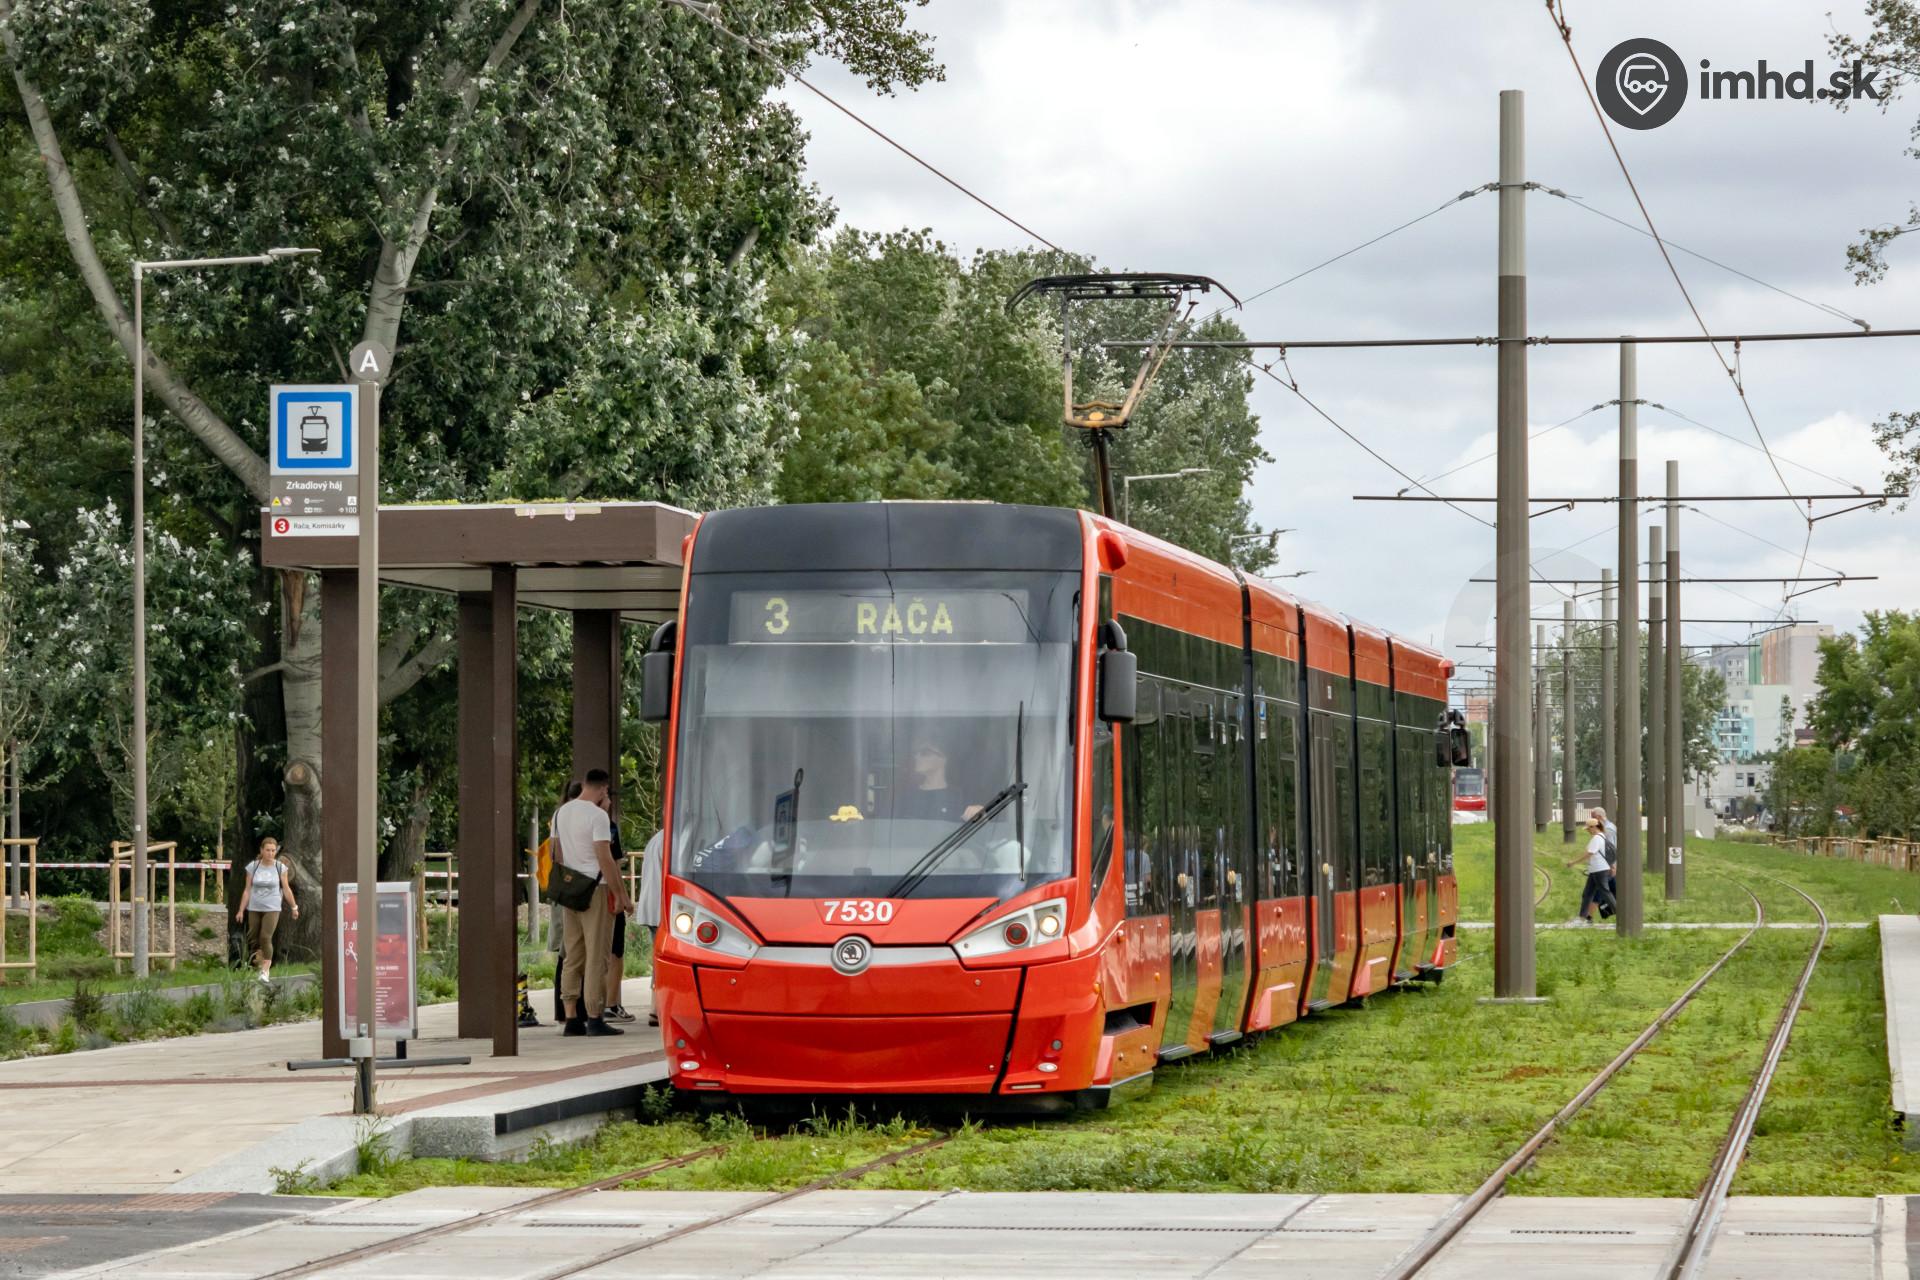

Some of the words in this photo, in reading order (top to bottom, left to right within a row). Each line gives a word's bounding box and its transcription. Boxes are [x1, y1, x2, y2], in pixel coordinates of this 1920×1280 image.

[359, 349, 379, 373] A
[286, 481, 328, 491] Zrkadlový
[329, 480, 342, 491] háj
[278, 521, 286, 532] 3
[312, 521, 345, 530] Komisárky
[765, 597, 790, 635] 3
[857, 597, 953, 634] RAČA
[823, 900, 893, 922] 7530
